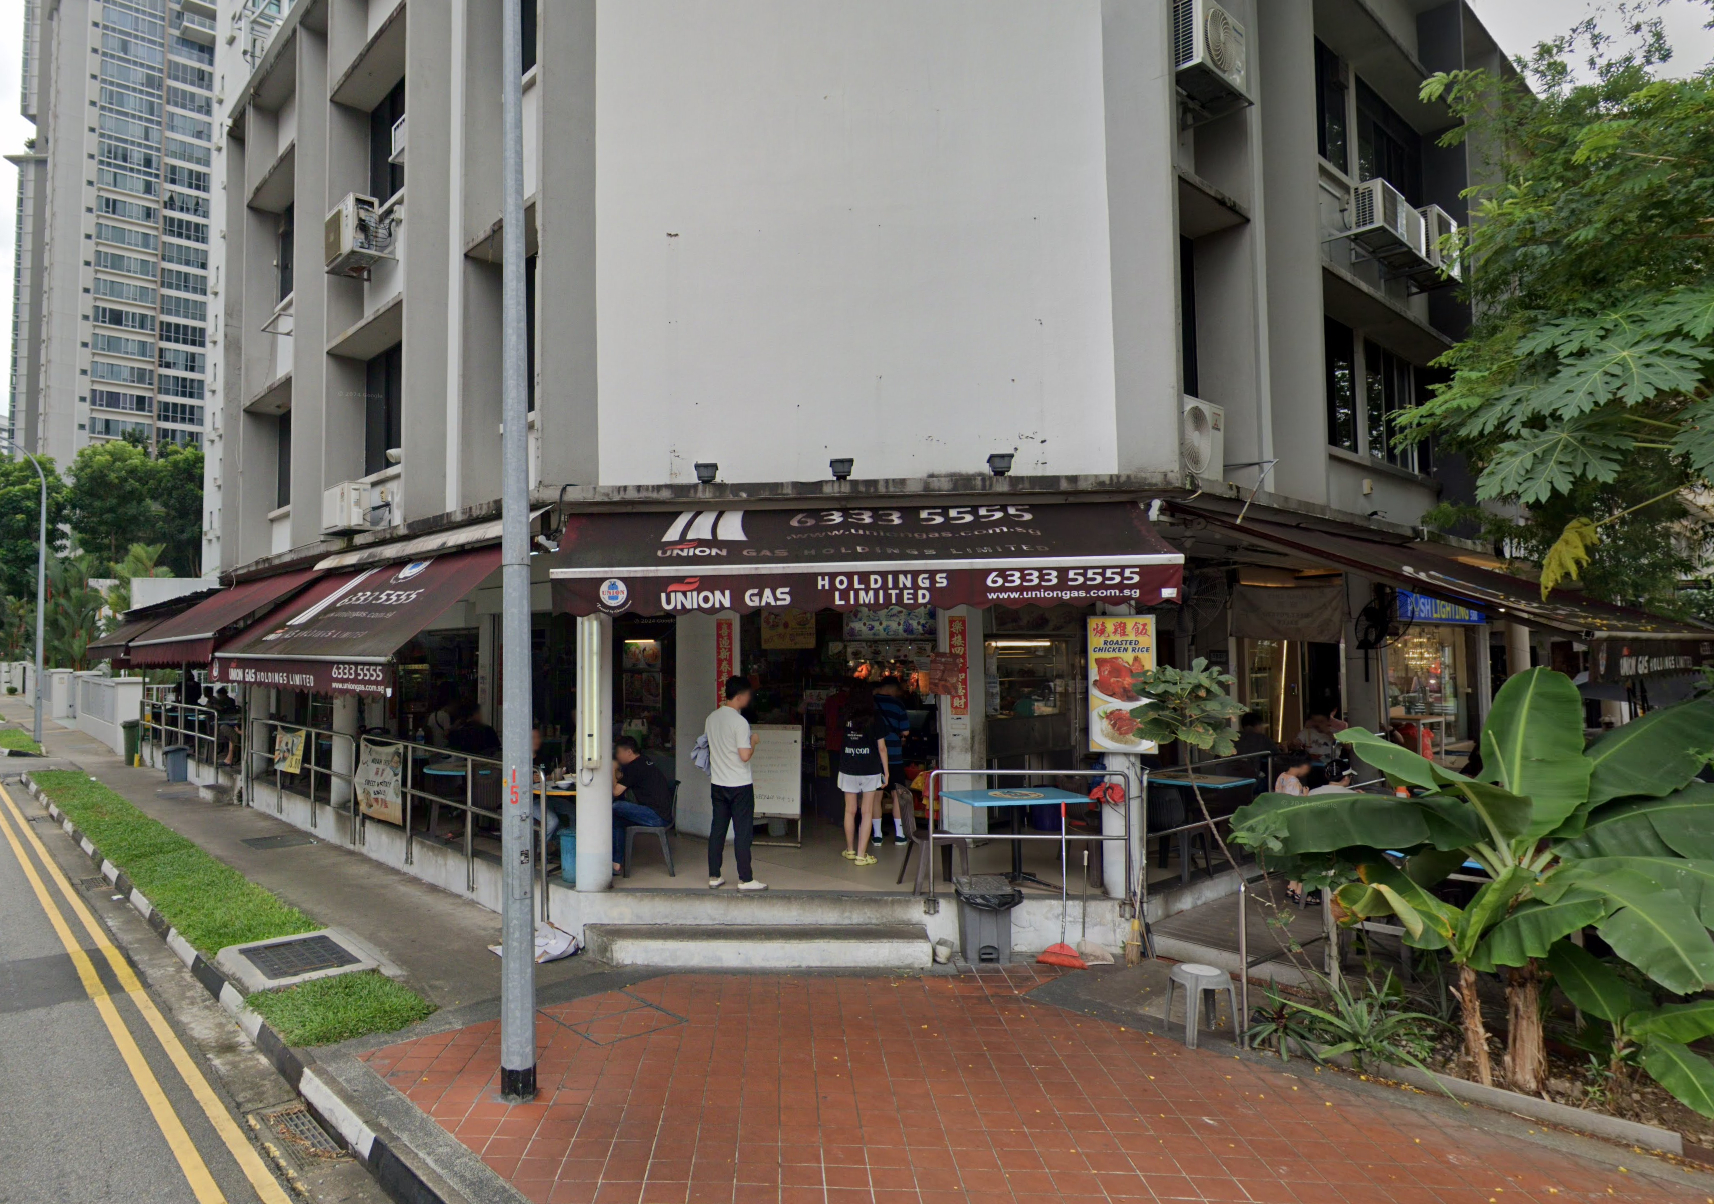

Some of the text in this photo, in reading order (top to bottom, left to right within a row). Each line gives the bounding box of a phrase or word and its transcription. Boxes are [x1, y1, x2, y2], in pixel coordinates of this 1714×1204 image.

[789, 505, 1034, 527] 6333 5555
[656, 544, 1050, 557] UNION GAS HOLDINGS LIMITED
[817, 573, 948, 590] HOLDINGS
[986, 568, 1140, 587] 6333 5555
[661, 587, 791, 610] UNION GAS
[834, 589, 930, 605] LIMITED
[987, 588, 1140, 599] www.uniongas.com.sg
[1432, 600, 1469, 620] LIGHTING
[1092, 621, 1150, 638] 燒雞飯
[256, 671, 287, 684] HOLDINGS
[289, 673, 314, 687] LIMITED
[332, 664, 383, 681] 6333 5555
